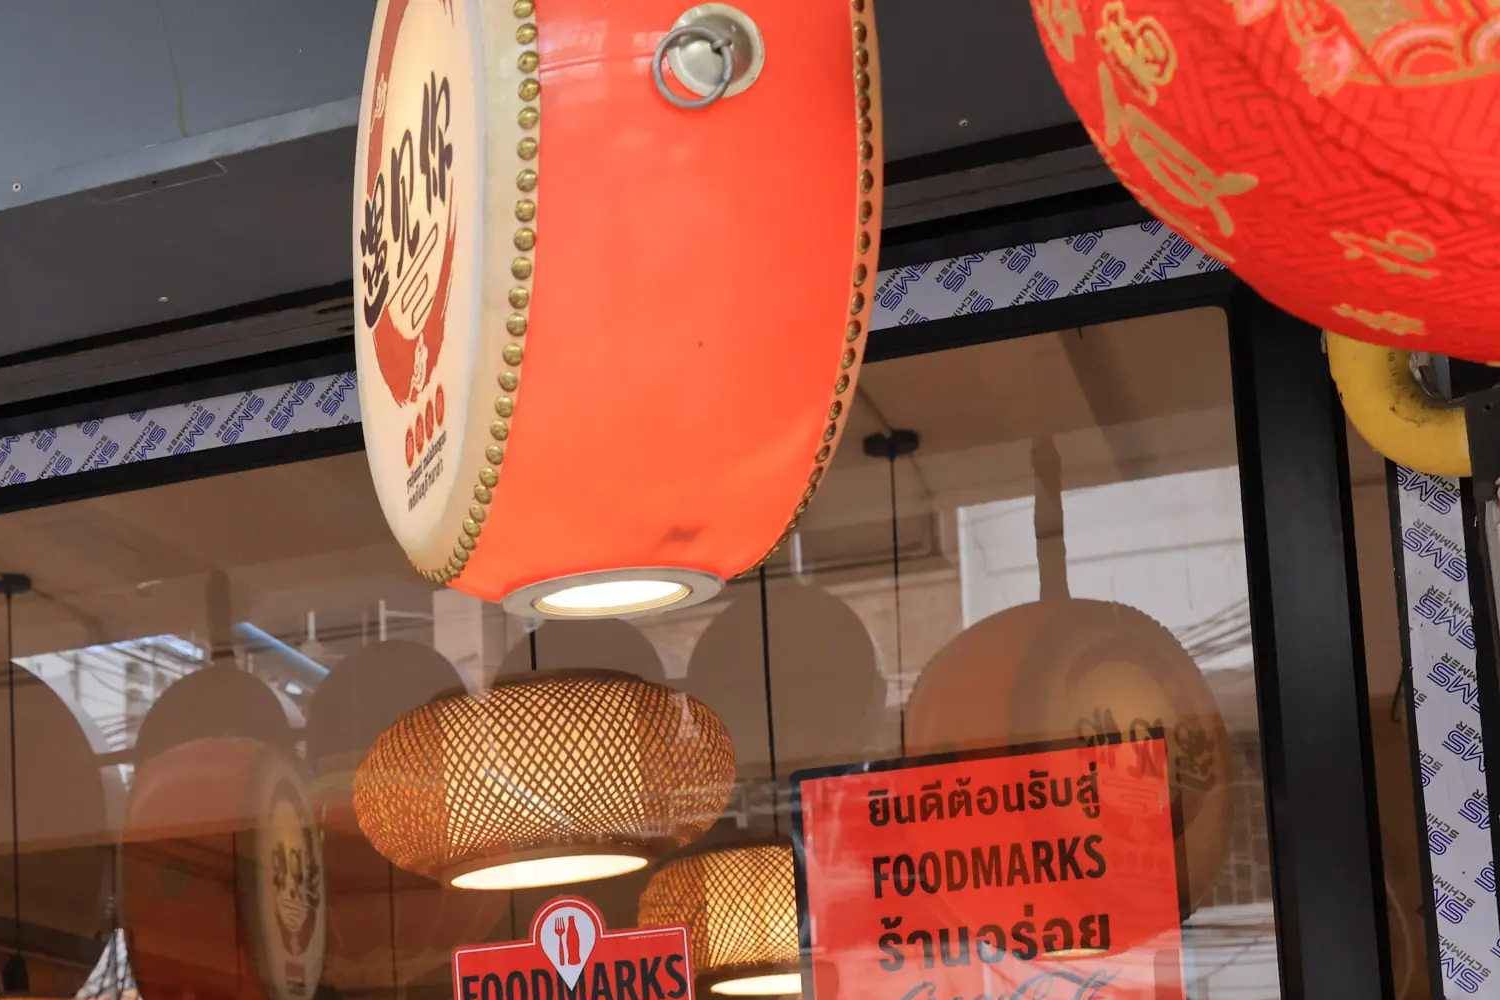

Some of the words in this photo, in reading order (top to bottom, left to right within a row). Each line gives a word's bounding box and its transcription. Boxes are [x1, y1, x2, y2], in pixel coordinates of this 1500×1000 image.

[360, 71, 453, 328] 遇见你
[1402, 526, 1468, 582] SMS
[867, 762, 1100, 826] ยินดีต้อนรับสู่
[872, 834, 1107, 898] FOODMARKS
[878, 904, 1111, 974] ร้านอร่อย
